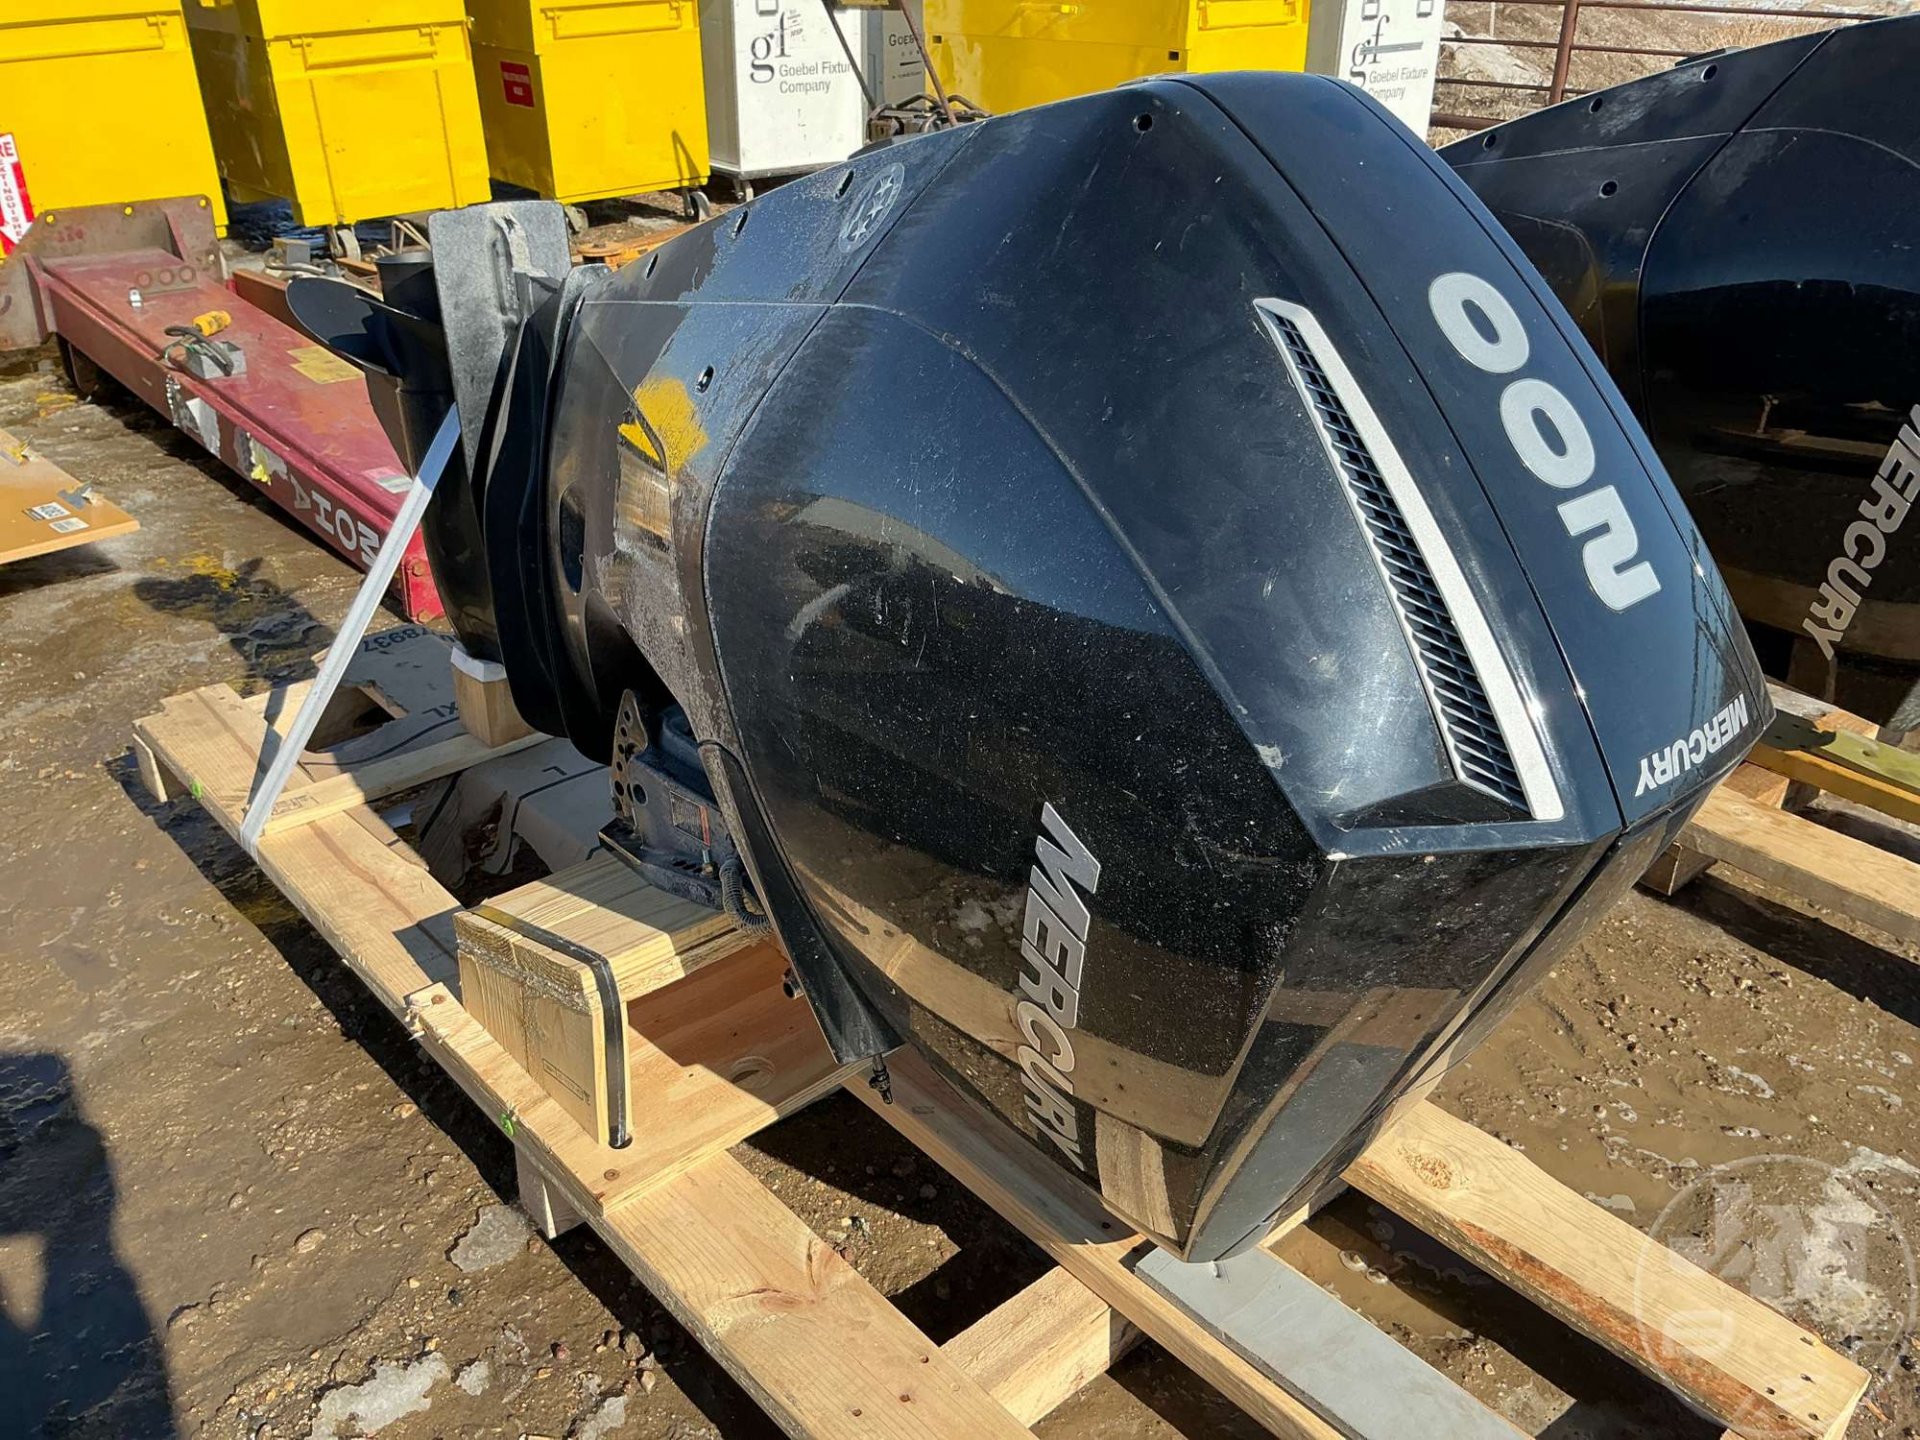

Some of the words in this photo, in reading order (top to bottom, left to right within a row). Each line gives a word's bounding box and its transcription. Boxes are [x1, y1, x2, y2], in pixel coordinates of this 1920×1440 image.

[779, 62, 819, 78] Goebel
[822, 61, 852, 76] Fixtur
[1369, 68, 1400, 84] Goebel
[1400, 67, 1429, 81] Fixture
[780, 80, 832, 95] Company
[1634, 693, 1748, 797] MERCURY
[1018, 801, 1101, 1172] MERCURY
